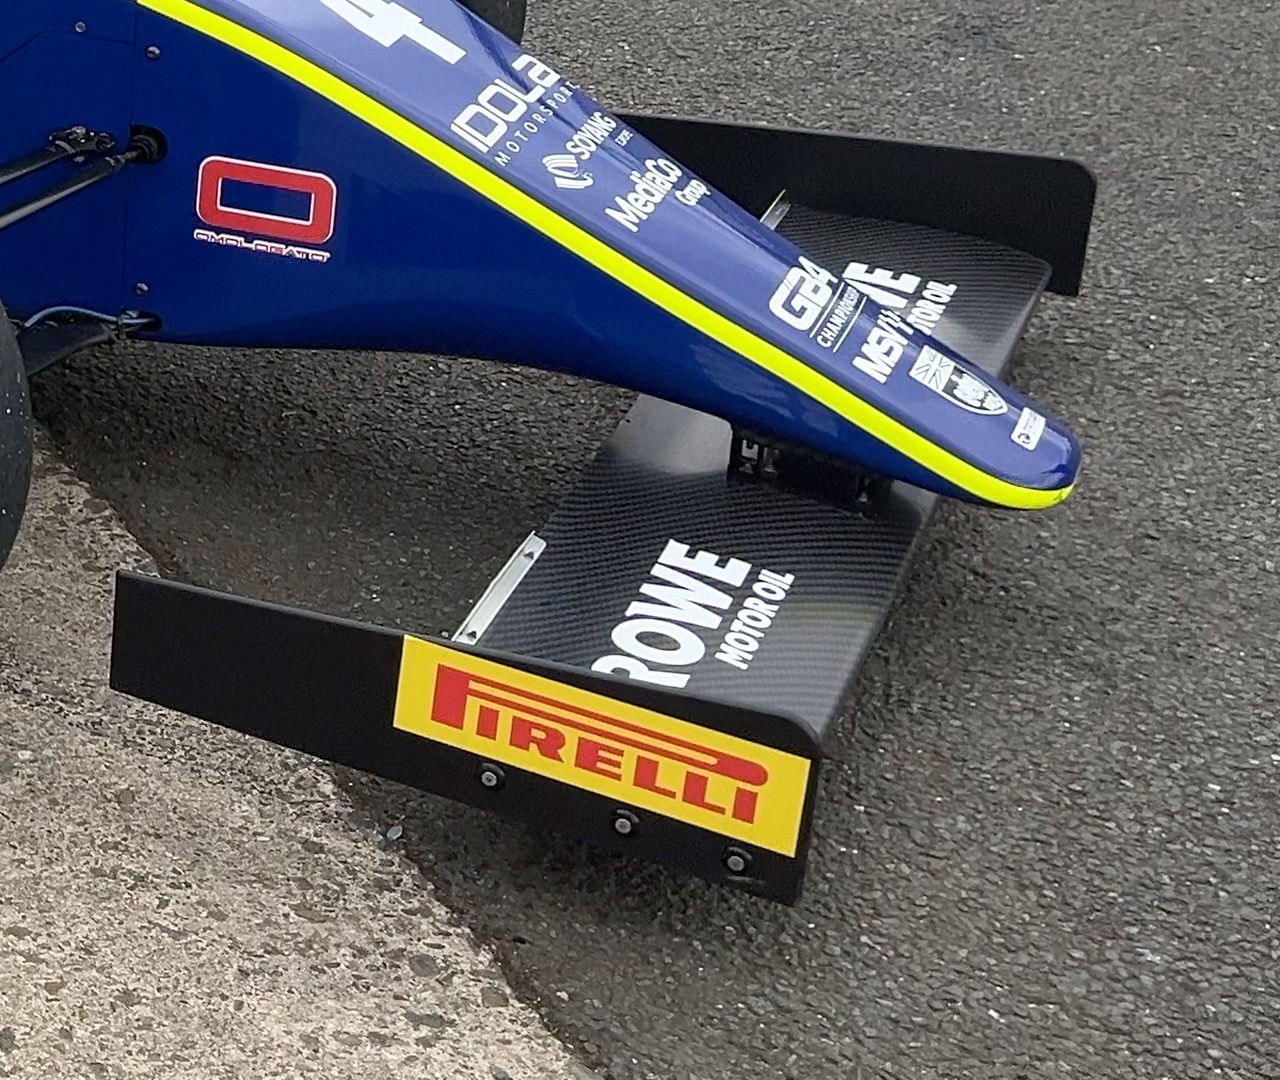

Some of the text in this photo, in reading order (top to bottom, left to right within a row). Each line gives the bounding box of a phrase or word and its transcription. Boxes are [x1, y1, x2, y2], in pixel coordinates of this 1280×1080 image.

[565, 111, 618, 161] SOYANG
[605, 158, 683, 233] MediaCo
[769, 256, 839, 331] GB4
[590, 538, 753, 689] ROWE
[714, 569, 795, 671] MOTOR OIL
[430, 663, 769, 825] PIRELLI
